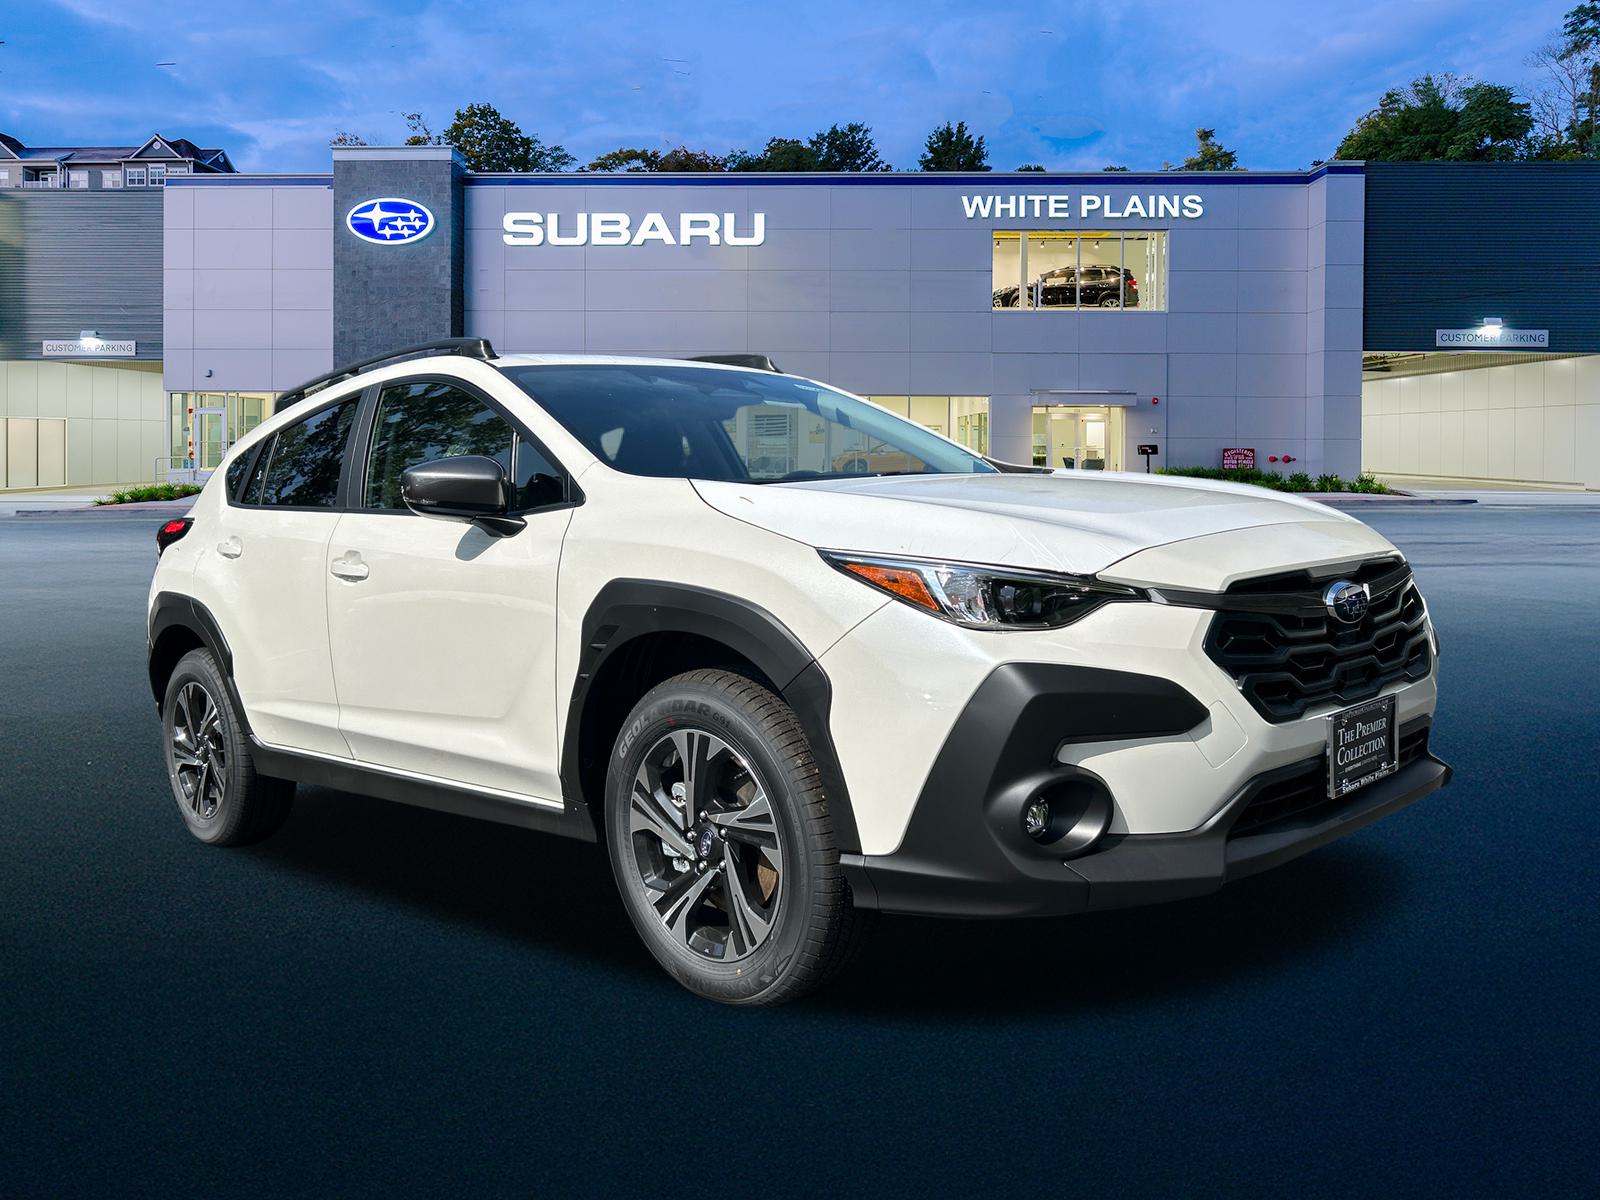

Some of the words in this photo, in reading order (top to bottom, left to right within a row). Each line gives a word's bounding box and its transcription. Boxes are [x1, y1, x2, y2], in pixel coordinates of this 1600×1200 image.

[961, 195, 1070, 219] WHITE
[1081, 194, 1204, 219] PLAINS
[502, 211, 766, 247] SUBARU
[45, 343, 92, 353] CUSTOMER
[94, 343, 133, 353] PARKING
[1440, 333, 1496, 343] CUSTOMER
[1501, 333, 1545, 343] PARKING
[1337, 727, 1355, 747] THE
[1355, 717, 1387, 740] PREMIER
[1337, 735, 1387, 766] COLLECTION
[1361, 774, 1375, 785] White
